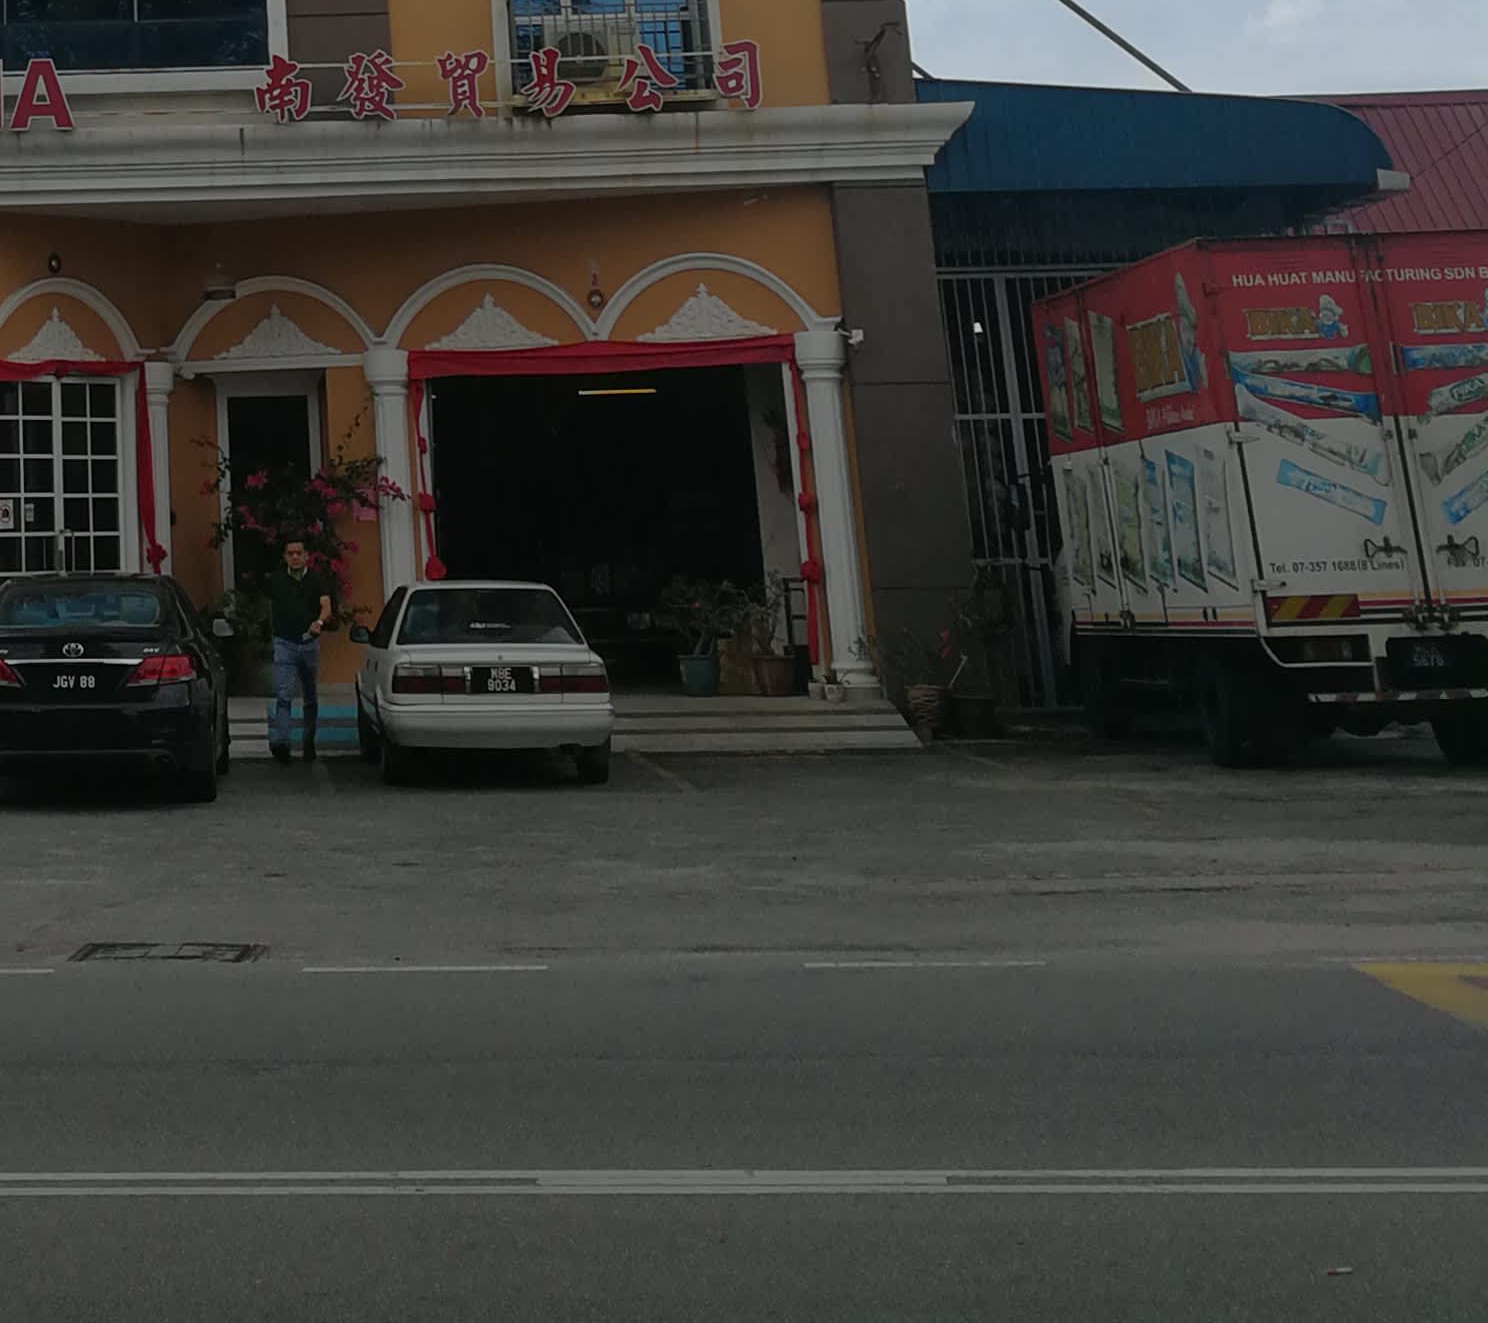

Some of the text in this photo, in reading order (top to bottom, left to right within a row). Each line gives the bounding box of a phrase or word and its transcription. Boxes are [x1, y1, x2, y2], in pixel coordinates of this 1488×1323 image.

[254, 40, 761, 123] 南發貿易公司
[1231, 273, 1265, 287] HUA
[1268, 271, 1308, 286] HUAT
[1444, 266, 1475, 281] SDN
[1269, 562, 1290, 573] Tel.
[52, 675, 96, 689] JGV 88
[487, 678, 517, 692] 9034
